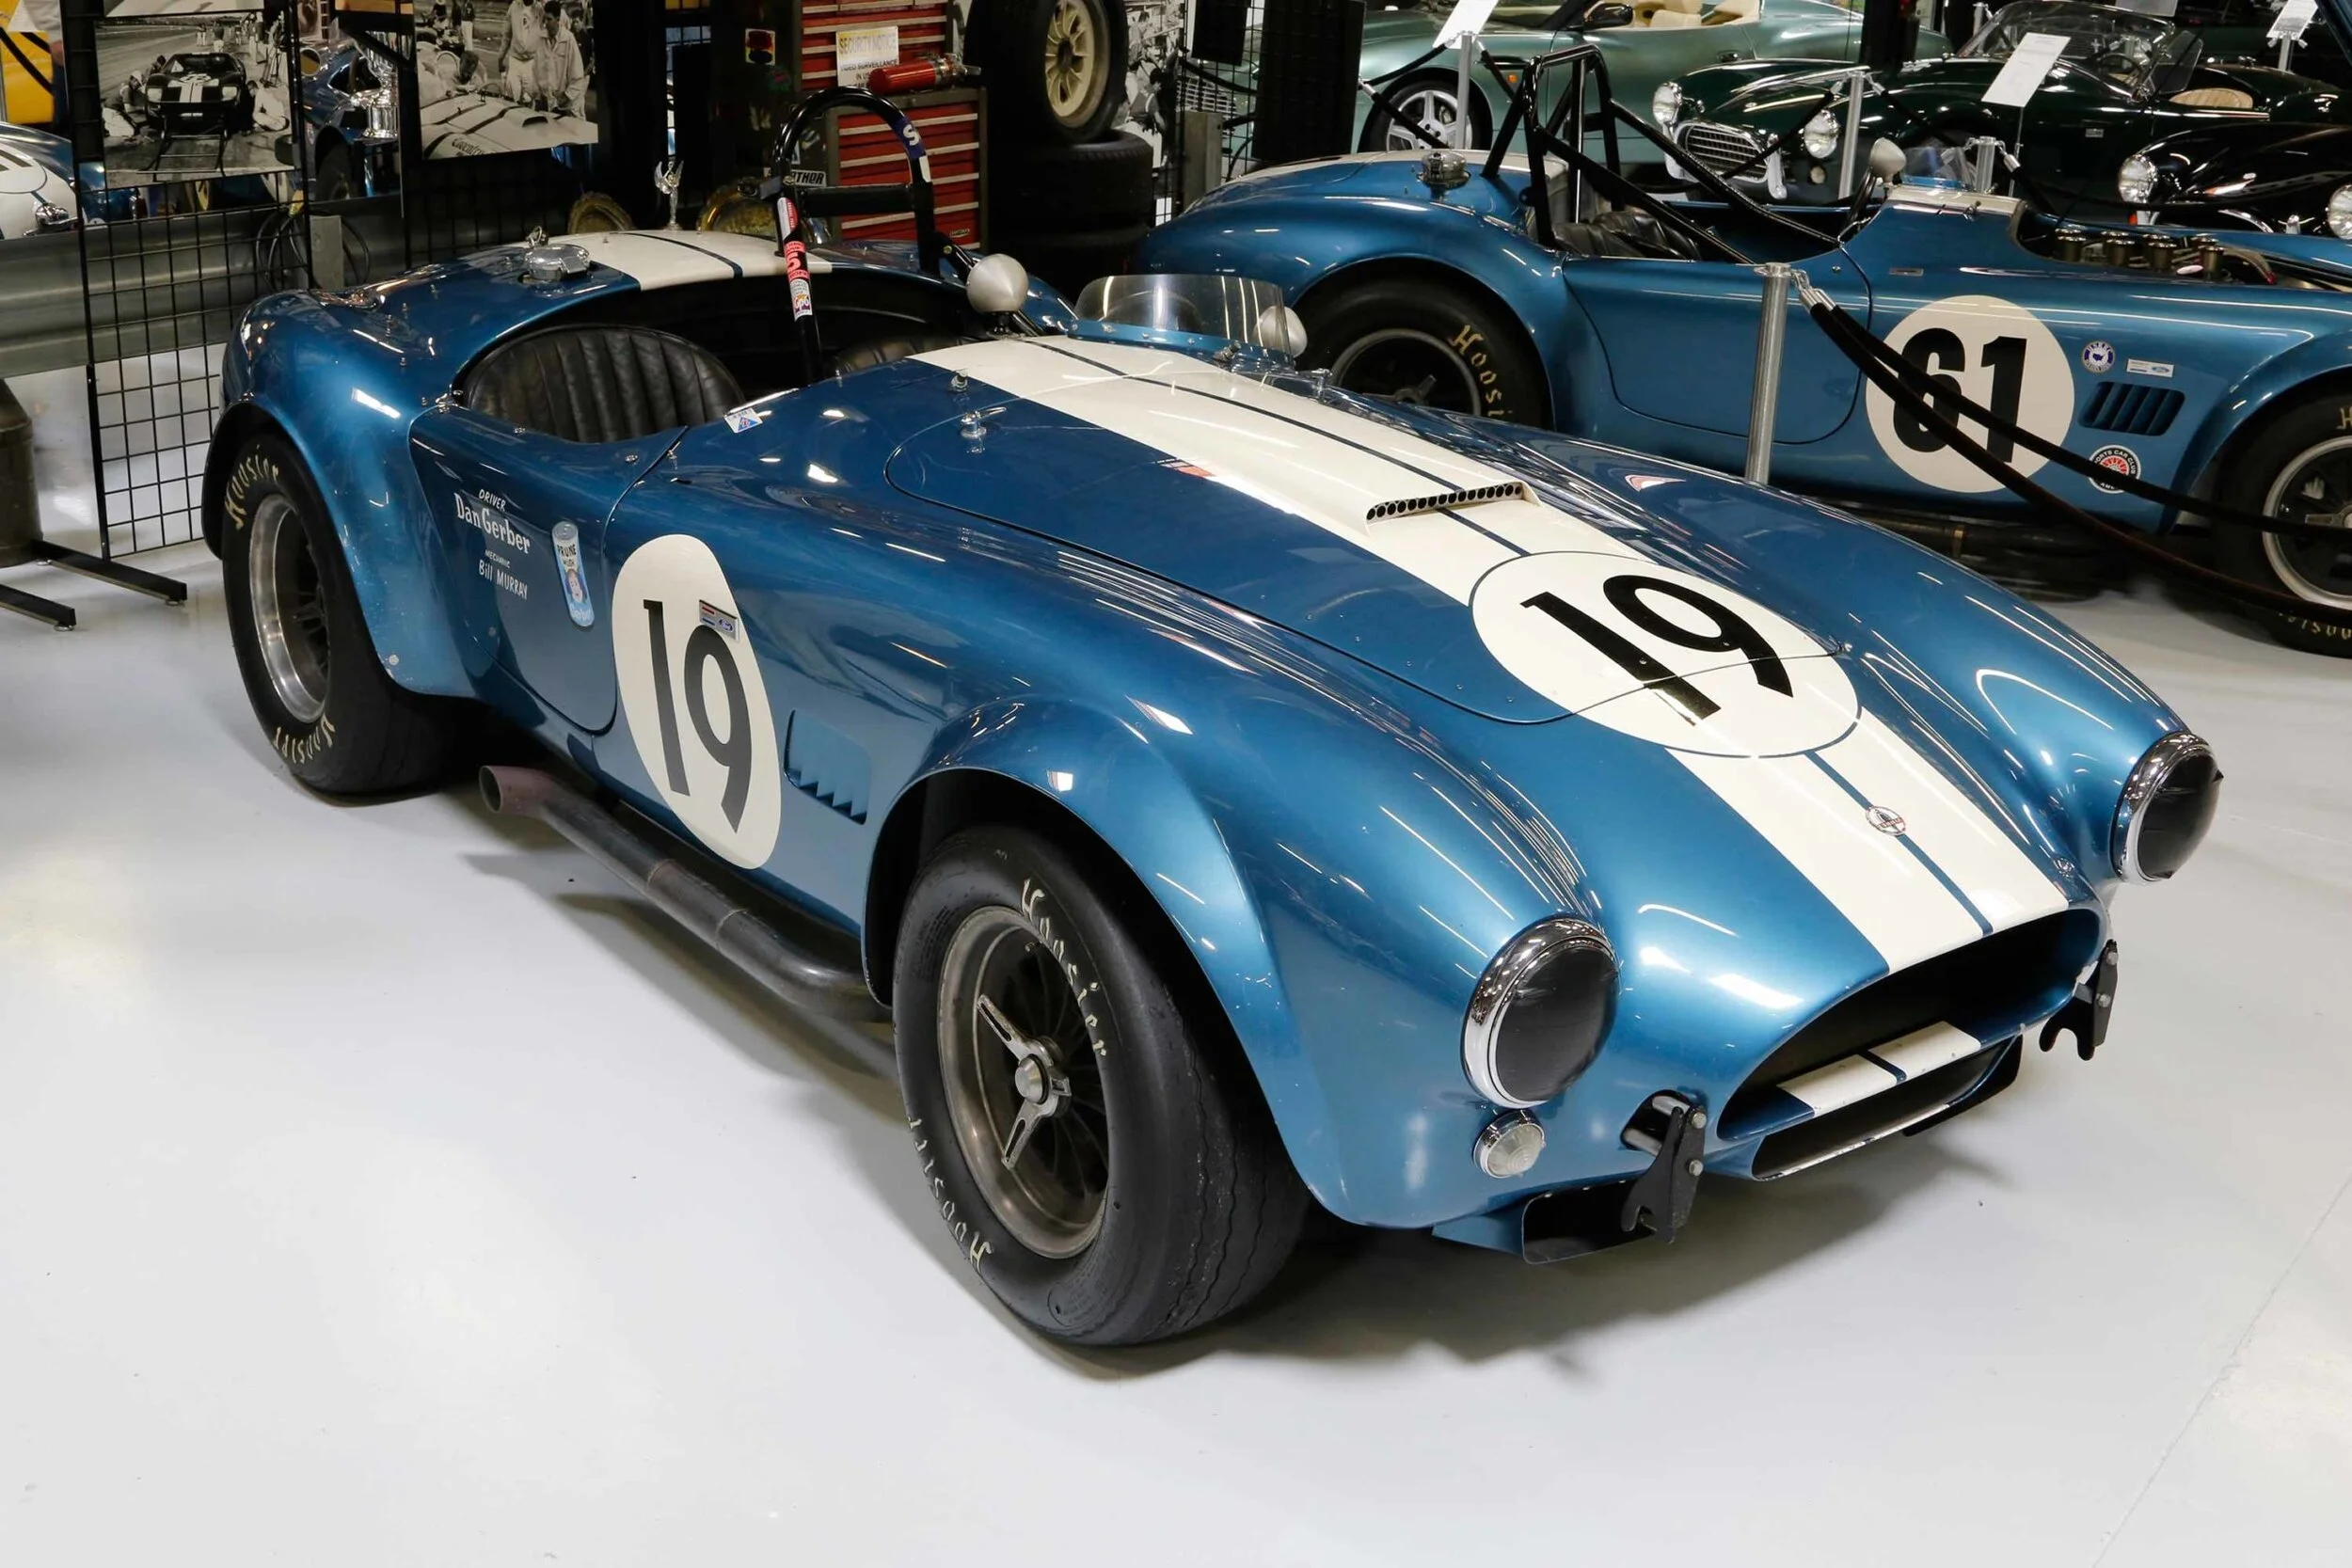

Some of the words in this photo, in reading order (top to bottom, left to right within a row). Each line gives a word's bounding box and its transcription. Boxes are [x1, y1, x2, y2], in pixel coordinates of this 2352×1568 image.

[838, 36, 873, 55] SECURITY
[874, 34, 898, 52] NOTICE
[857, 58, 898, 71] SURVEILLANCE
[1447, 324, 1514, 418] Hoosi
[1893, 327, 2027, 463] 61
[2094, 450, 2113, 464] ORTS
[2113, 450, 2129, 459] CAR
[2127, 457, 2137, 475] CLUB
[478, 488, 507, 513] DRIVER
[485, 548, 511, 569] MECHANIC
[556, 544, 577, 558] PRUNE
[478, 559, 493, 581] Bill
[496, 568, 528, 601] MURRAY
[1519, 574, 1793, 726] 19
[643, 598, 753, 834] 19
